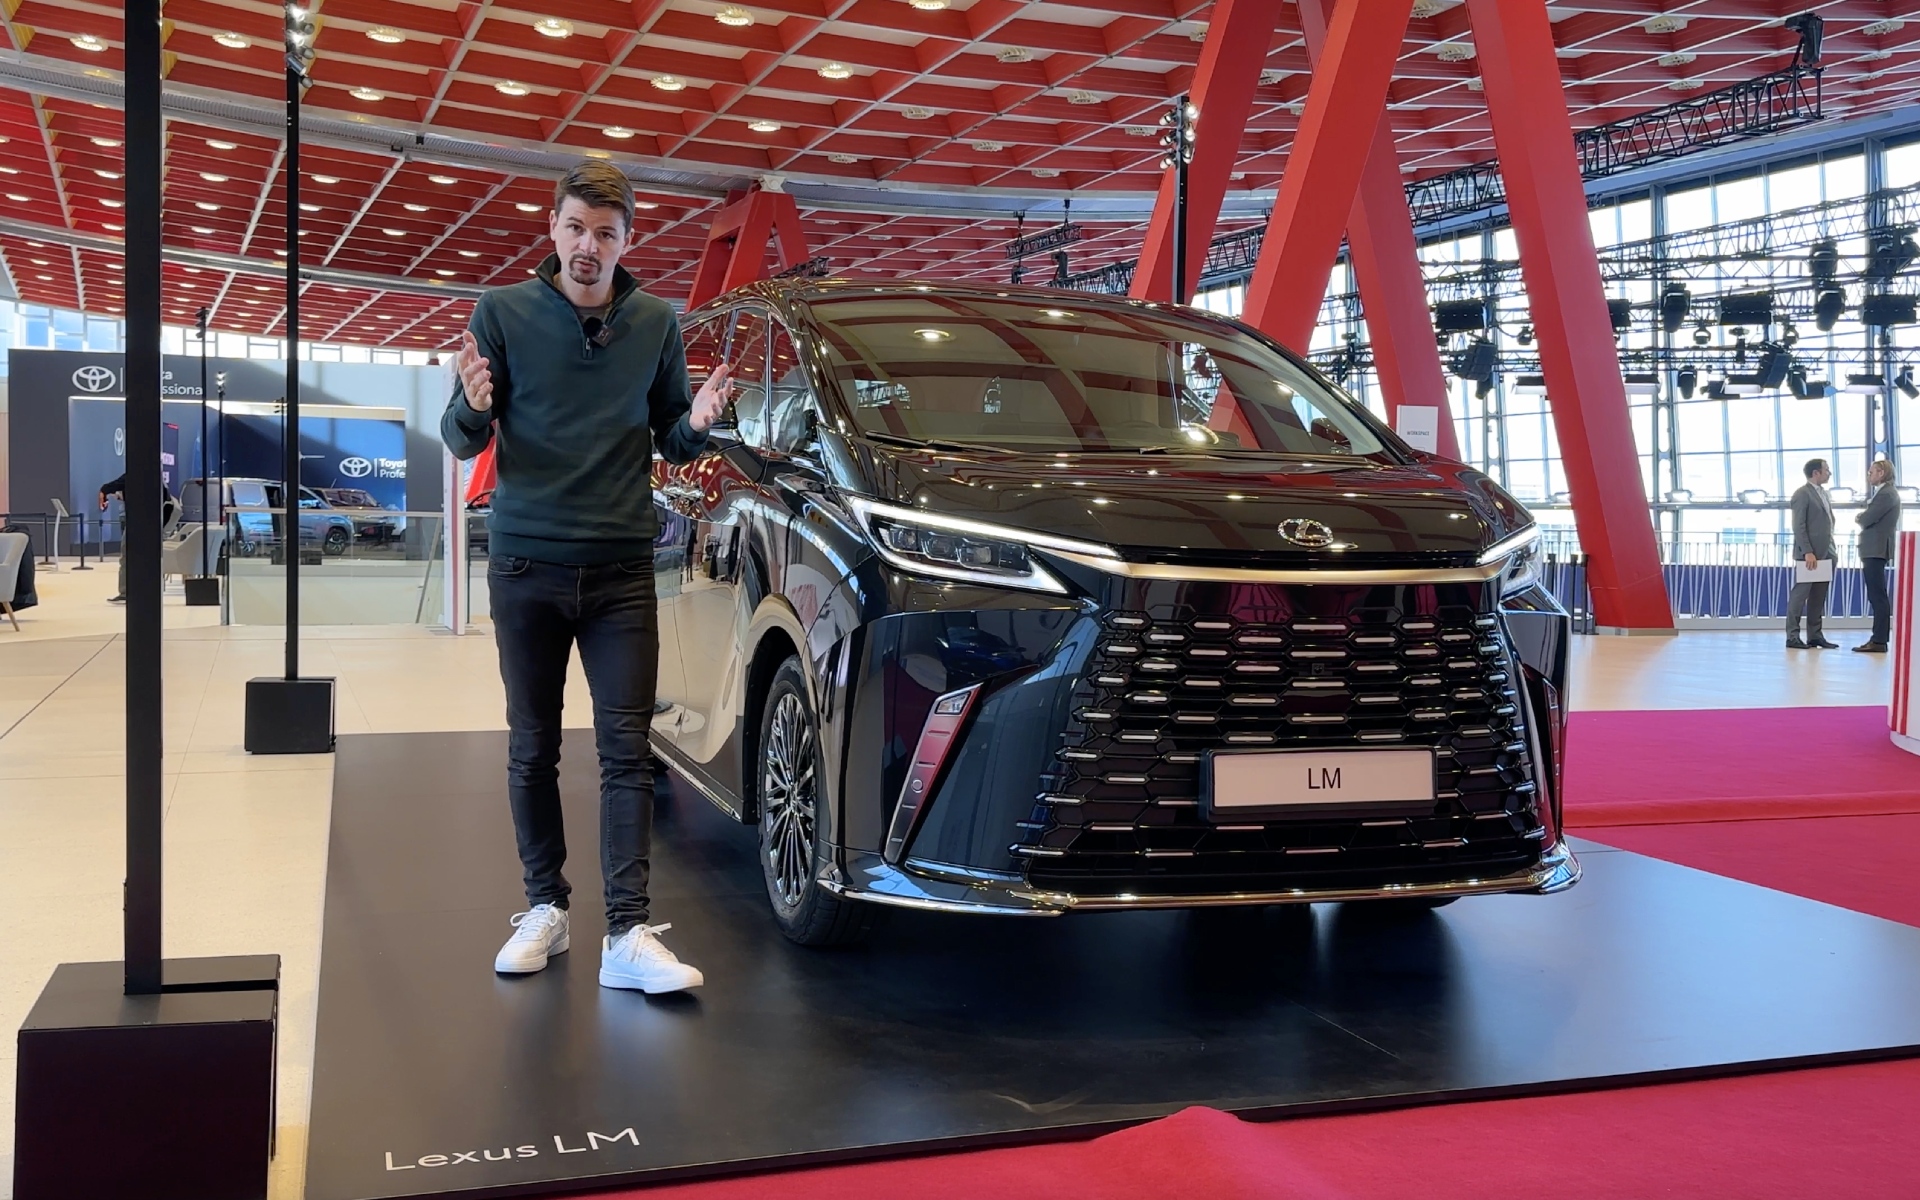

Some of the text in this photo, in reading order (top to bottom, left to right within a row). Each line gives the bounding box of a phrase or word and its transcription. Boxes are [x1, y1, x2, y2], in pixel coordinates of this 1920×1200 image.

[1307, 767, 1342, 790] LM
[384, 1127, 641, 1171] Lexus LM
